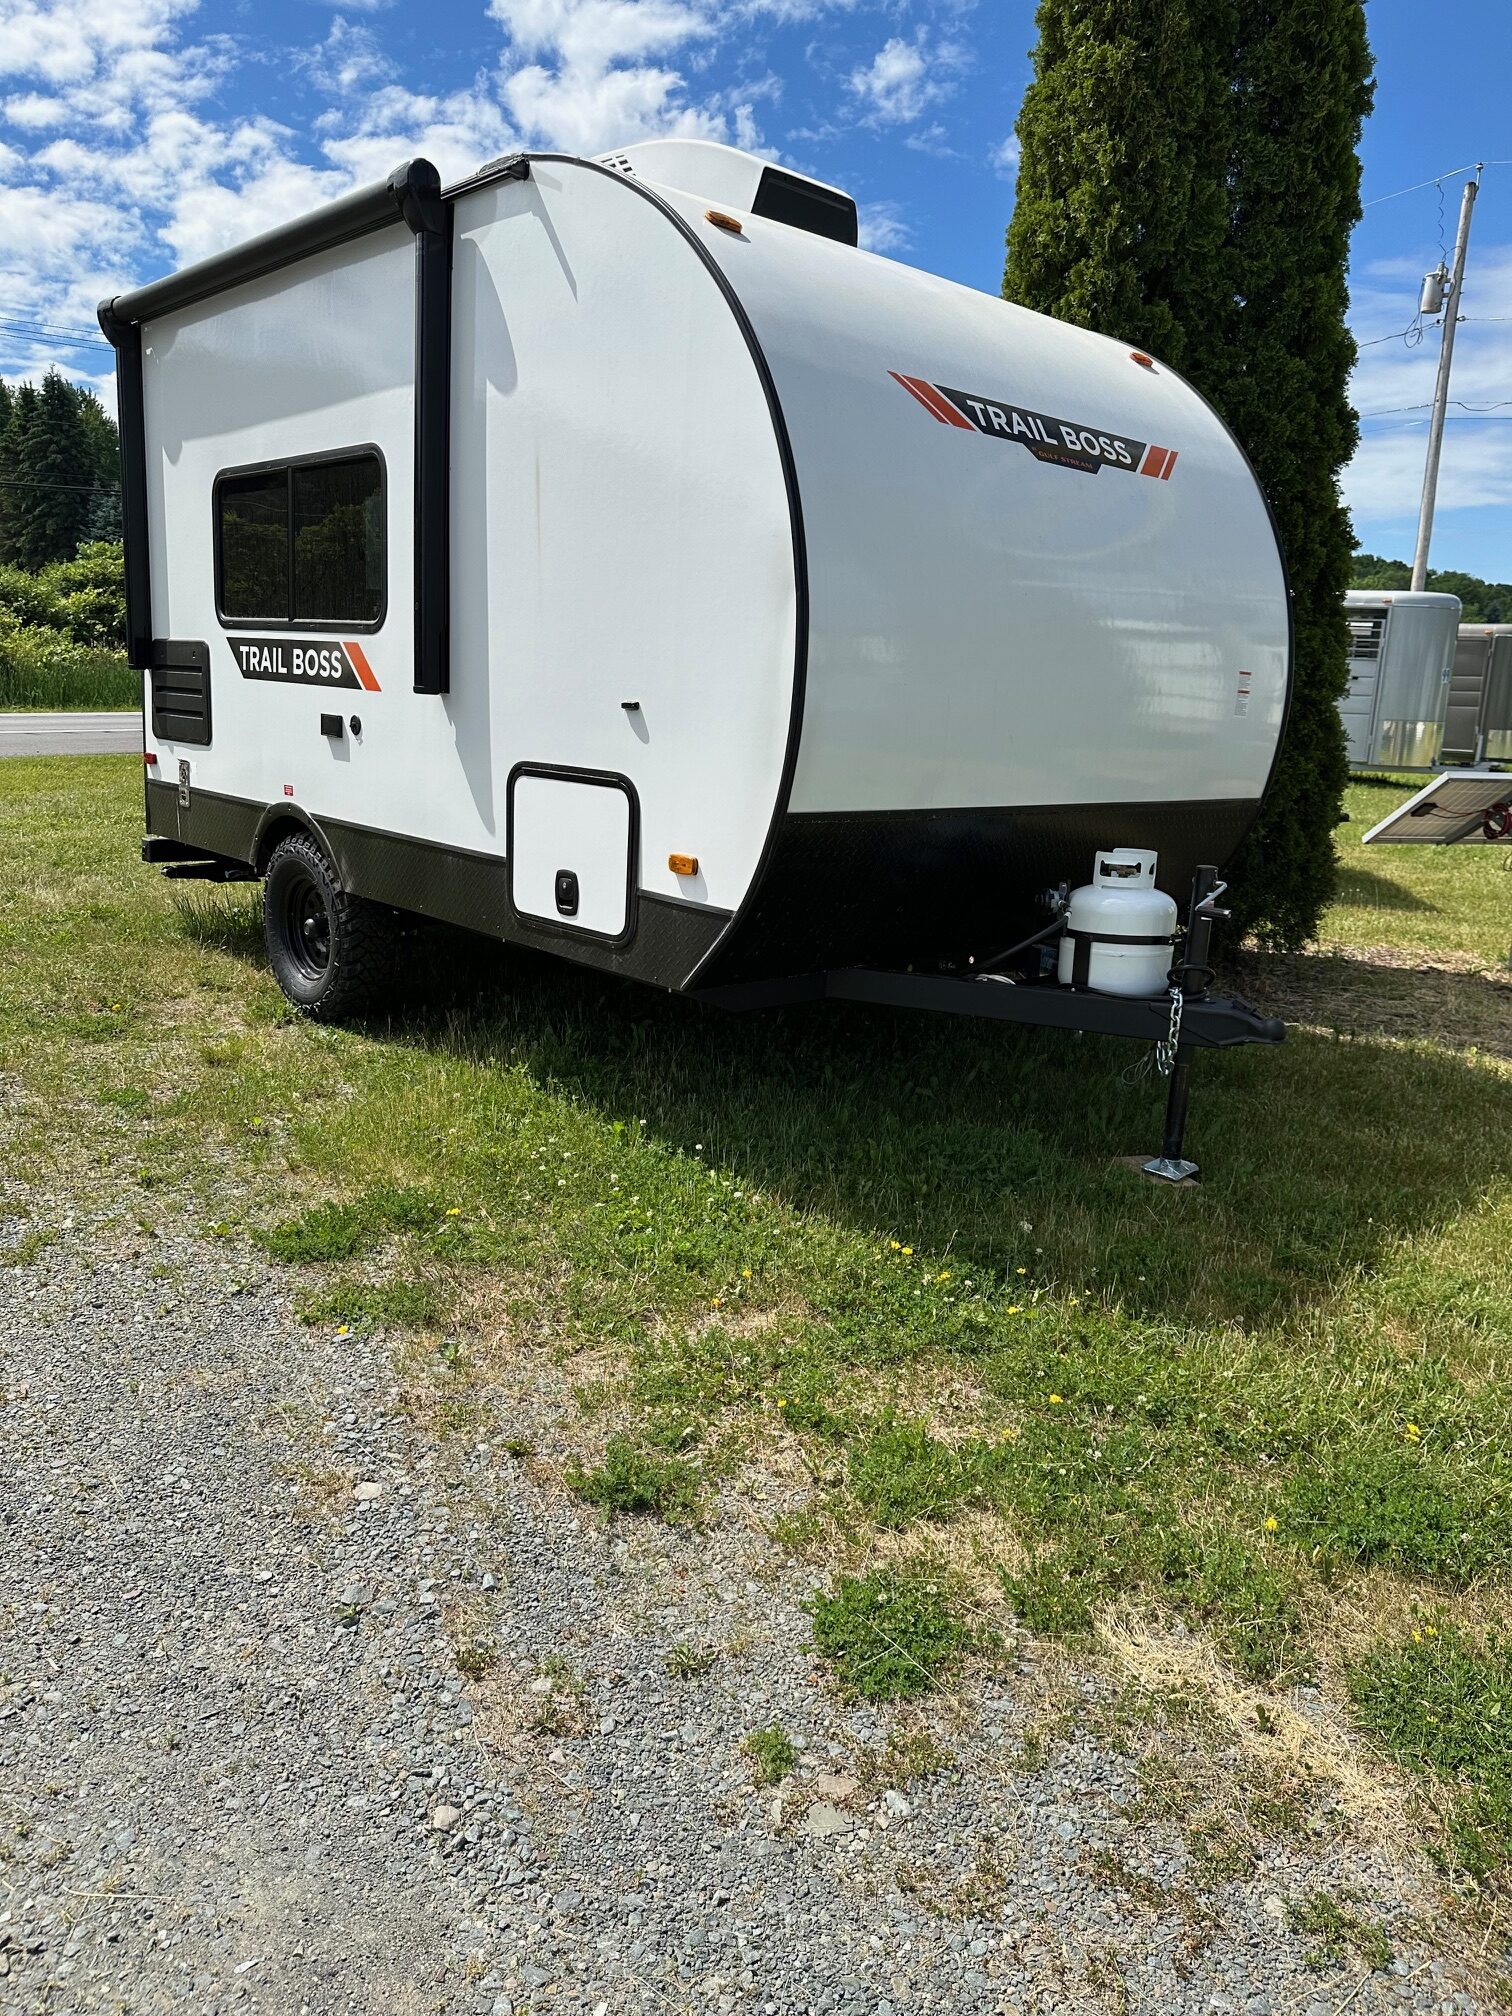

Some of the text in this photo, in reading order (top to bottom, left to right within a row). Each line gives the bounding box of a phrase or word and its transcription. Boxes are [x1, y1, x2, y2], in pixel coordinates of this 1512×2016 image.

[966, 399, 1132, 464] TRAIL BOSS
[1060, 456, 1093, 469] STREAM
[239, 645, 342, 679] TRAIL BOSS
